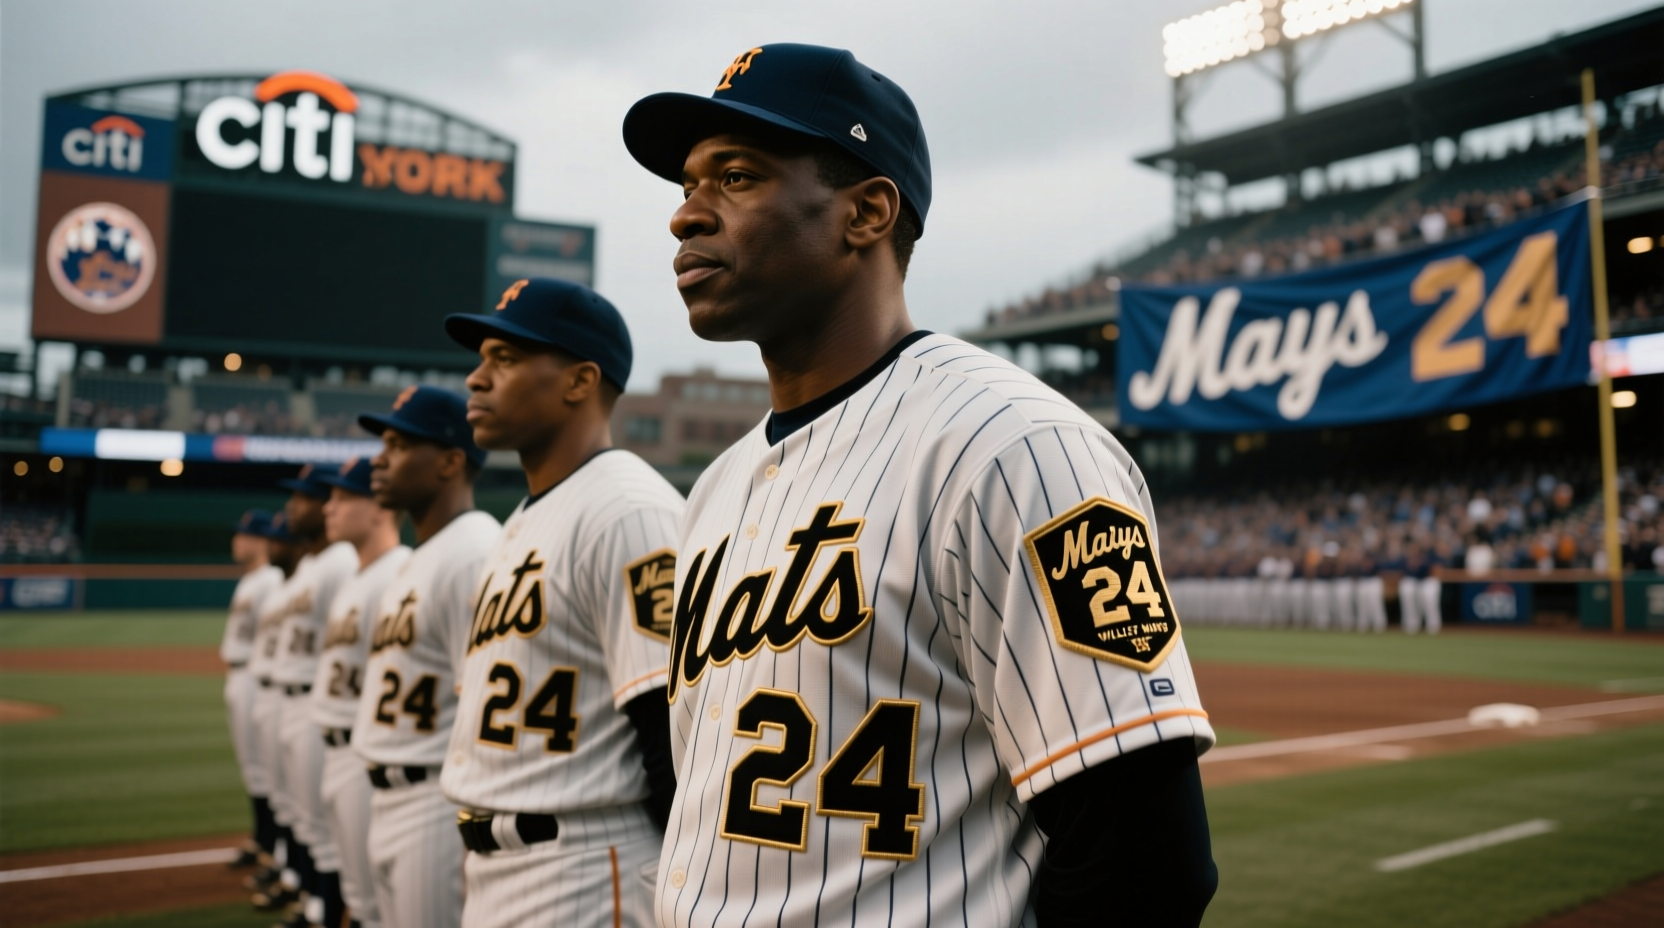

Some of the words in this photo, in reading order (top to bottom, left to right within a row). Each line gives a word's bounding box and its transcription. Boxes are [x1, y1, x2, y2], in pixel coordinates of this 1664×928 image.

[61, 127, 143, 173] citi
[196, 91, 356, 183] citi
[357, 142, 506, 204] YORK
[1128, 287, 1389, 420] Mays
[1410, 230, 1569, 382] 24
[668, 500, 874, 705] Mats
[1081, 560, 1165, 628] 24
[373, 667, 440, 734] 24
[476, 659, 581, 754] 24
[719, 687, 926, 861] 24
